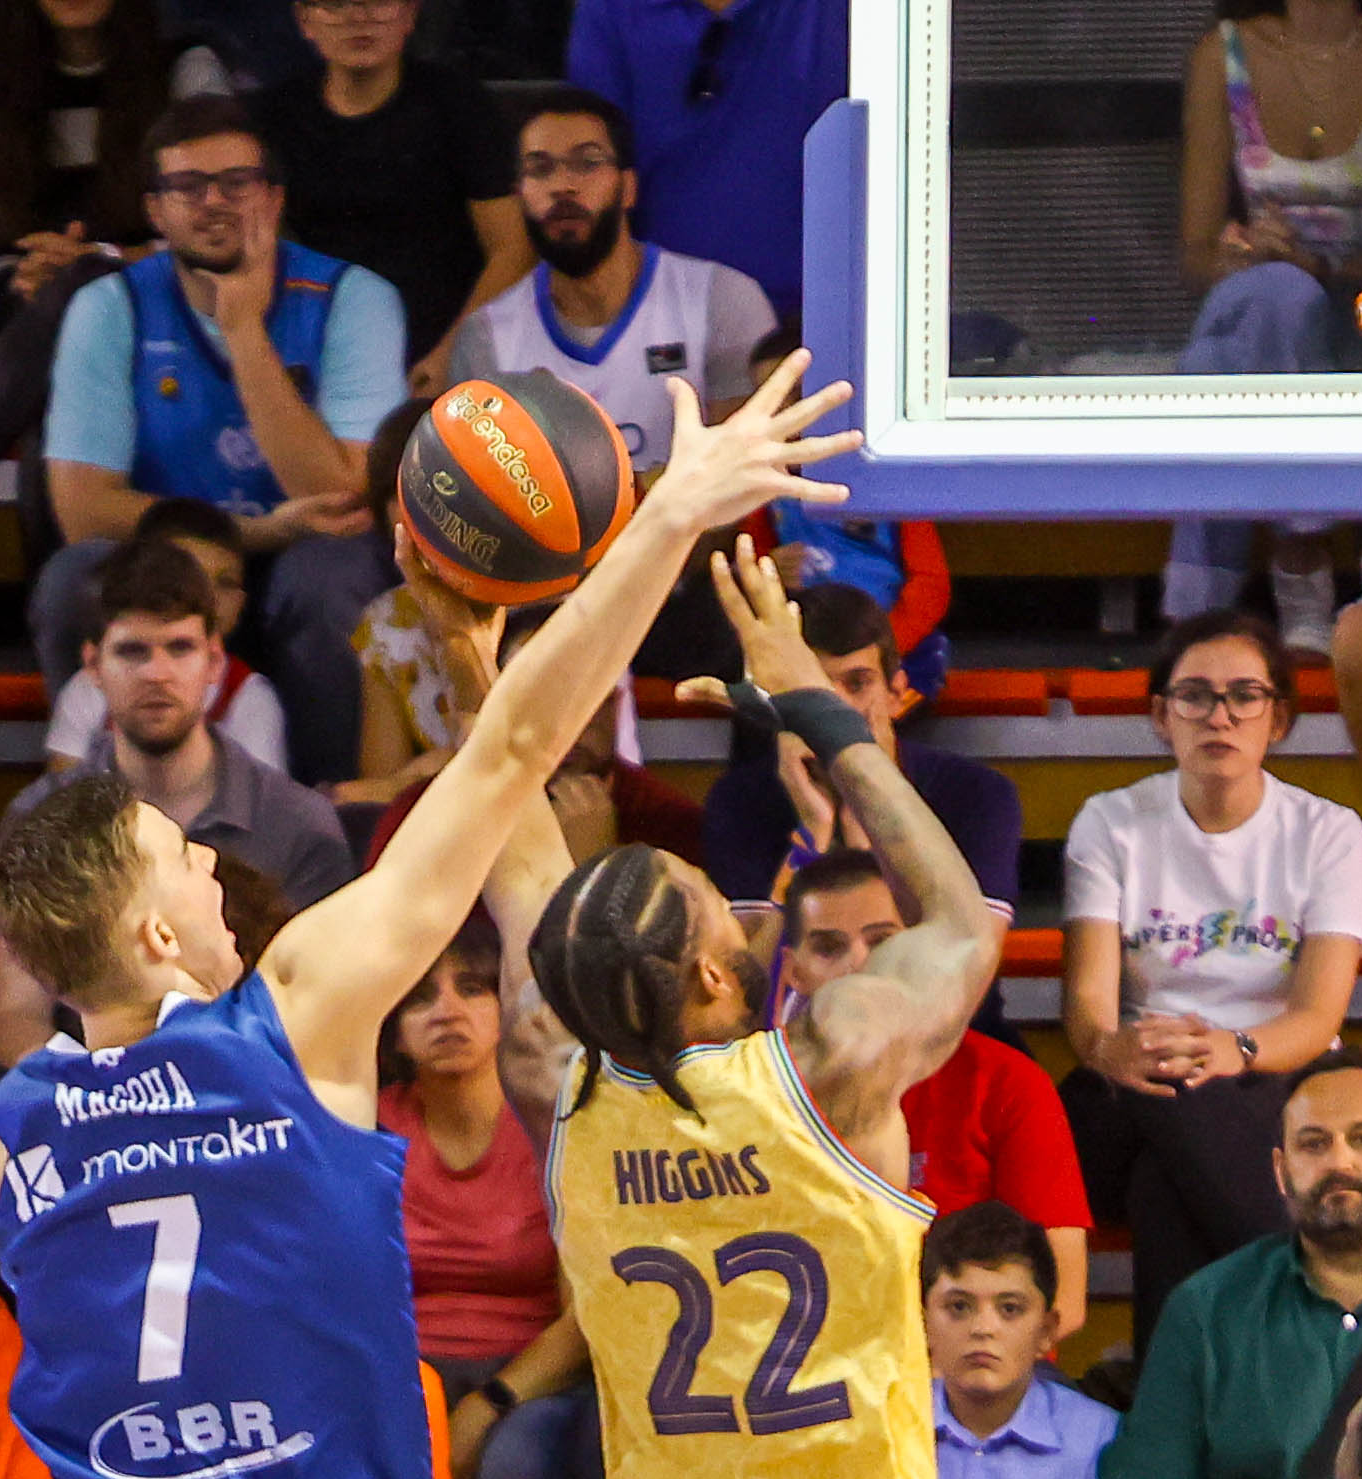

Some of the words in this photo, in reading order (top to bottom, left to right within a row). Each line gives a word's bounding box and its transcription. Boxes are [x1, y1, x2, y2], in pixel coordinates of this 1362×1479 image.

[471, 415, 553, 518] endesa
[613, 1145, 770, 1206] HIGGINS
[110, 1194, 202, 1383] 7
[611, 1232, 850, 1436] 22
